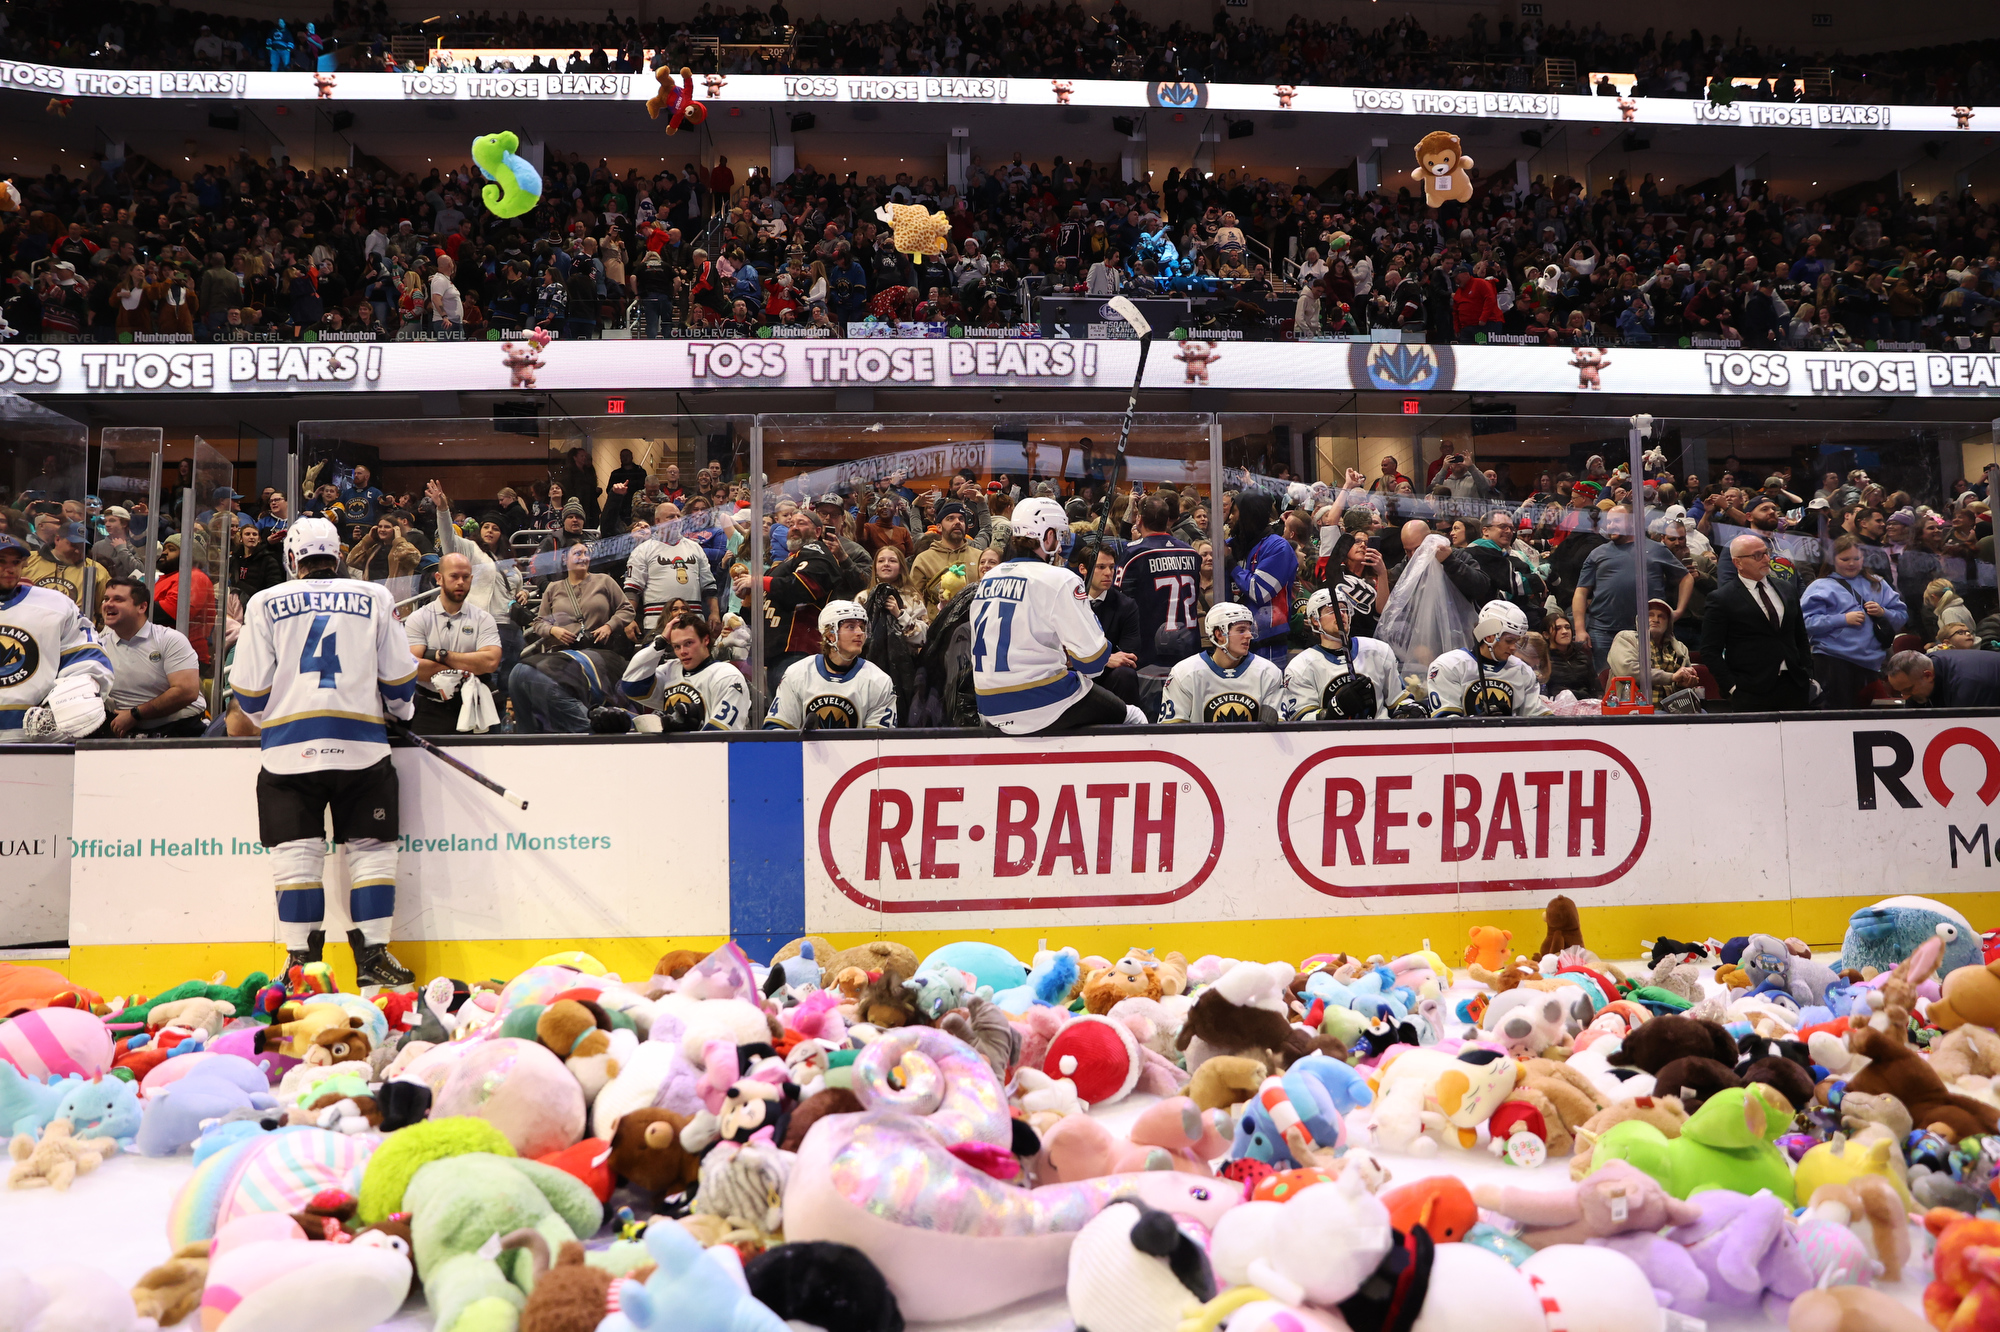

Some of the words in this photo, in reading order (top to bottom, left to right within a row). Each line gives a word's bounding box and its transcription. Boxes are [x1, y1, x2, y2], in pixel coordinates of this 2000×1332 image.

[1522, 4, 1542, 15] 211
[1813, 15, 1832, 25] 212
[0, 62, 64, 89] TOSS
[76, 74, 152, 95] THOSE
[402, 75, 457, 95] TOSS
[467, 78, 539, 98] THOSE
[784, 77, 838, 97] TOSS
[848, 80, 919, 100] THOSE
[1353, 90, 1403, 110] TOSS
[1412, 94, 1478, 114] THOSE
[1693, 102, 1741, 121] TOSS
[1750, 106, 1811, 126] THOSE
[25, 333, 55, 342] CLUB
[58, 333, 98, 342] LEVEL
[133, 331, 193, 343] Huntington
[213, 333, 243, 342] CLUB
[249, 332, 283, 341] LEVEL
[318, 329, 377, 342] Huntington
[397, 331, 427, 341] CLUB
[430, 331, 466, 340] LEVEL
[670, 329, 703, 338] CLUB
[772, 325, 830, 339] Huntington
[963, 325, 1021, 338] Huntington
[1188, 327, 1243, 340] Huntington
[1285, 330, 1319, 340] CLUB
[1321, 330, 1350, 340] LEVEL
[1488, 331, 1540, 345] Huntington
[1691, 336, 1741, 349] Huntington
[1877, 339, 1926, 351] Huntington
[687, 342, 787, 378] TOSS
[805, 347, 935, 383] THOSE
[81, 353, 214, 389] THOSE
[1704, 352, 1791, 387] TOSS
[1805, 359, 1917, 393] THOSE
[1927, 355, 2000, 388] BEA
[607, 400, 625, 413] EXIT
[1404, 401, 1419, 414] EXIT
[1118, 396, 1136, 453] CCM
[318, 543, 325, 552] 4
[1149, 556, 1196, 573] BOBROVSKY
[267, 592, 371, 622] CEULEMANS
[1154, 574, 1198, 632] 72
[973, 601, 1017, 672] 41
[299, 615, 342, 689] 4
[664, 684, 701, 705] CLEVELAND
[1209, 694, 1256, 710] CLEVELAND
[809, 697, 854, 715] CLEVELAND
[1159, 700, 1175, 723] 93
[150, 837, 223, 857] Health
[506, 832, 612, 851] Monsters
[373, 965, 399, 984] CCM
